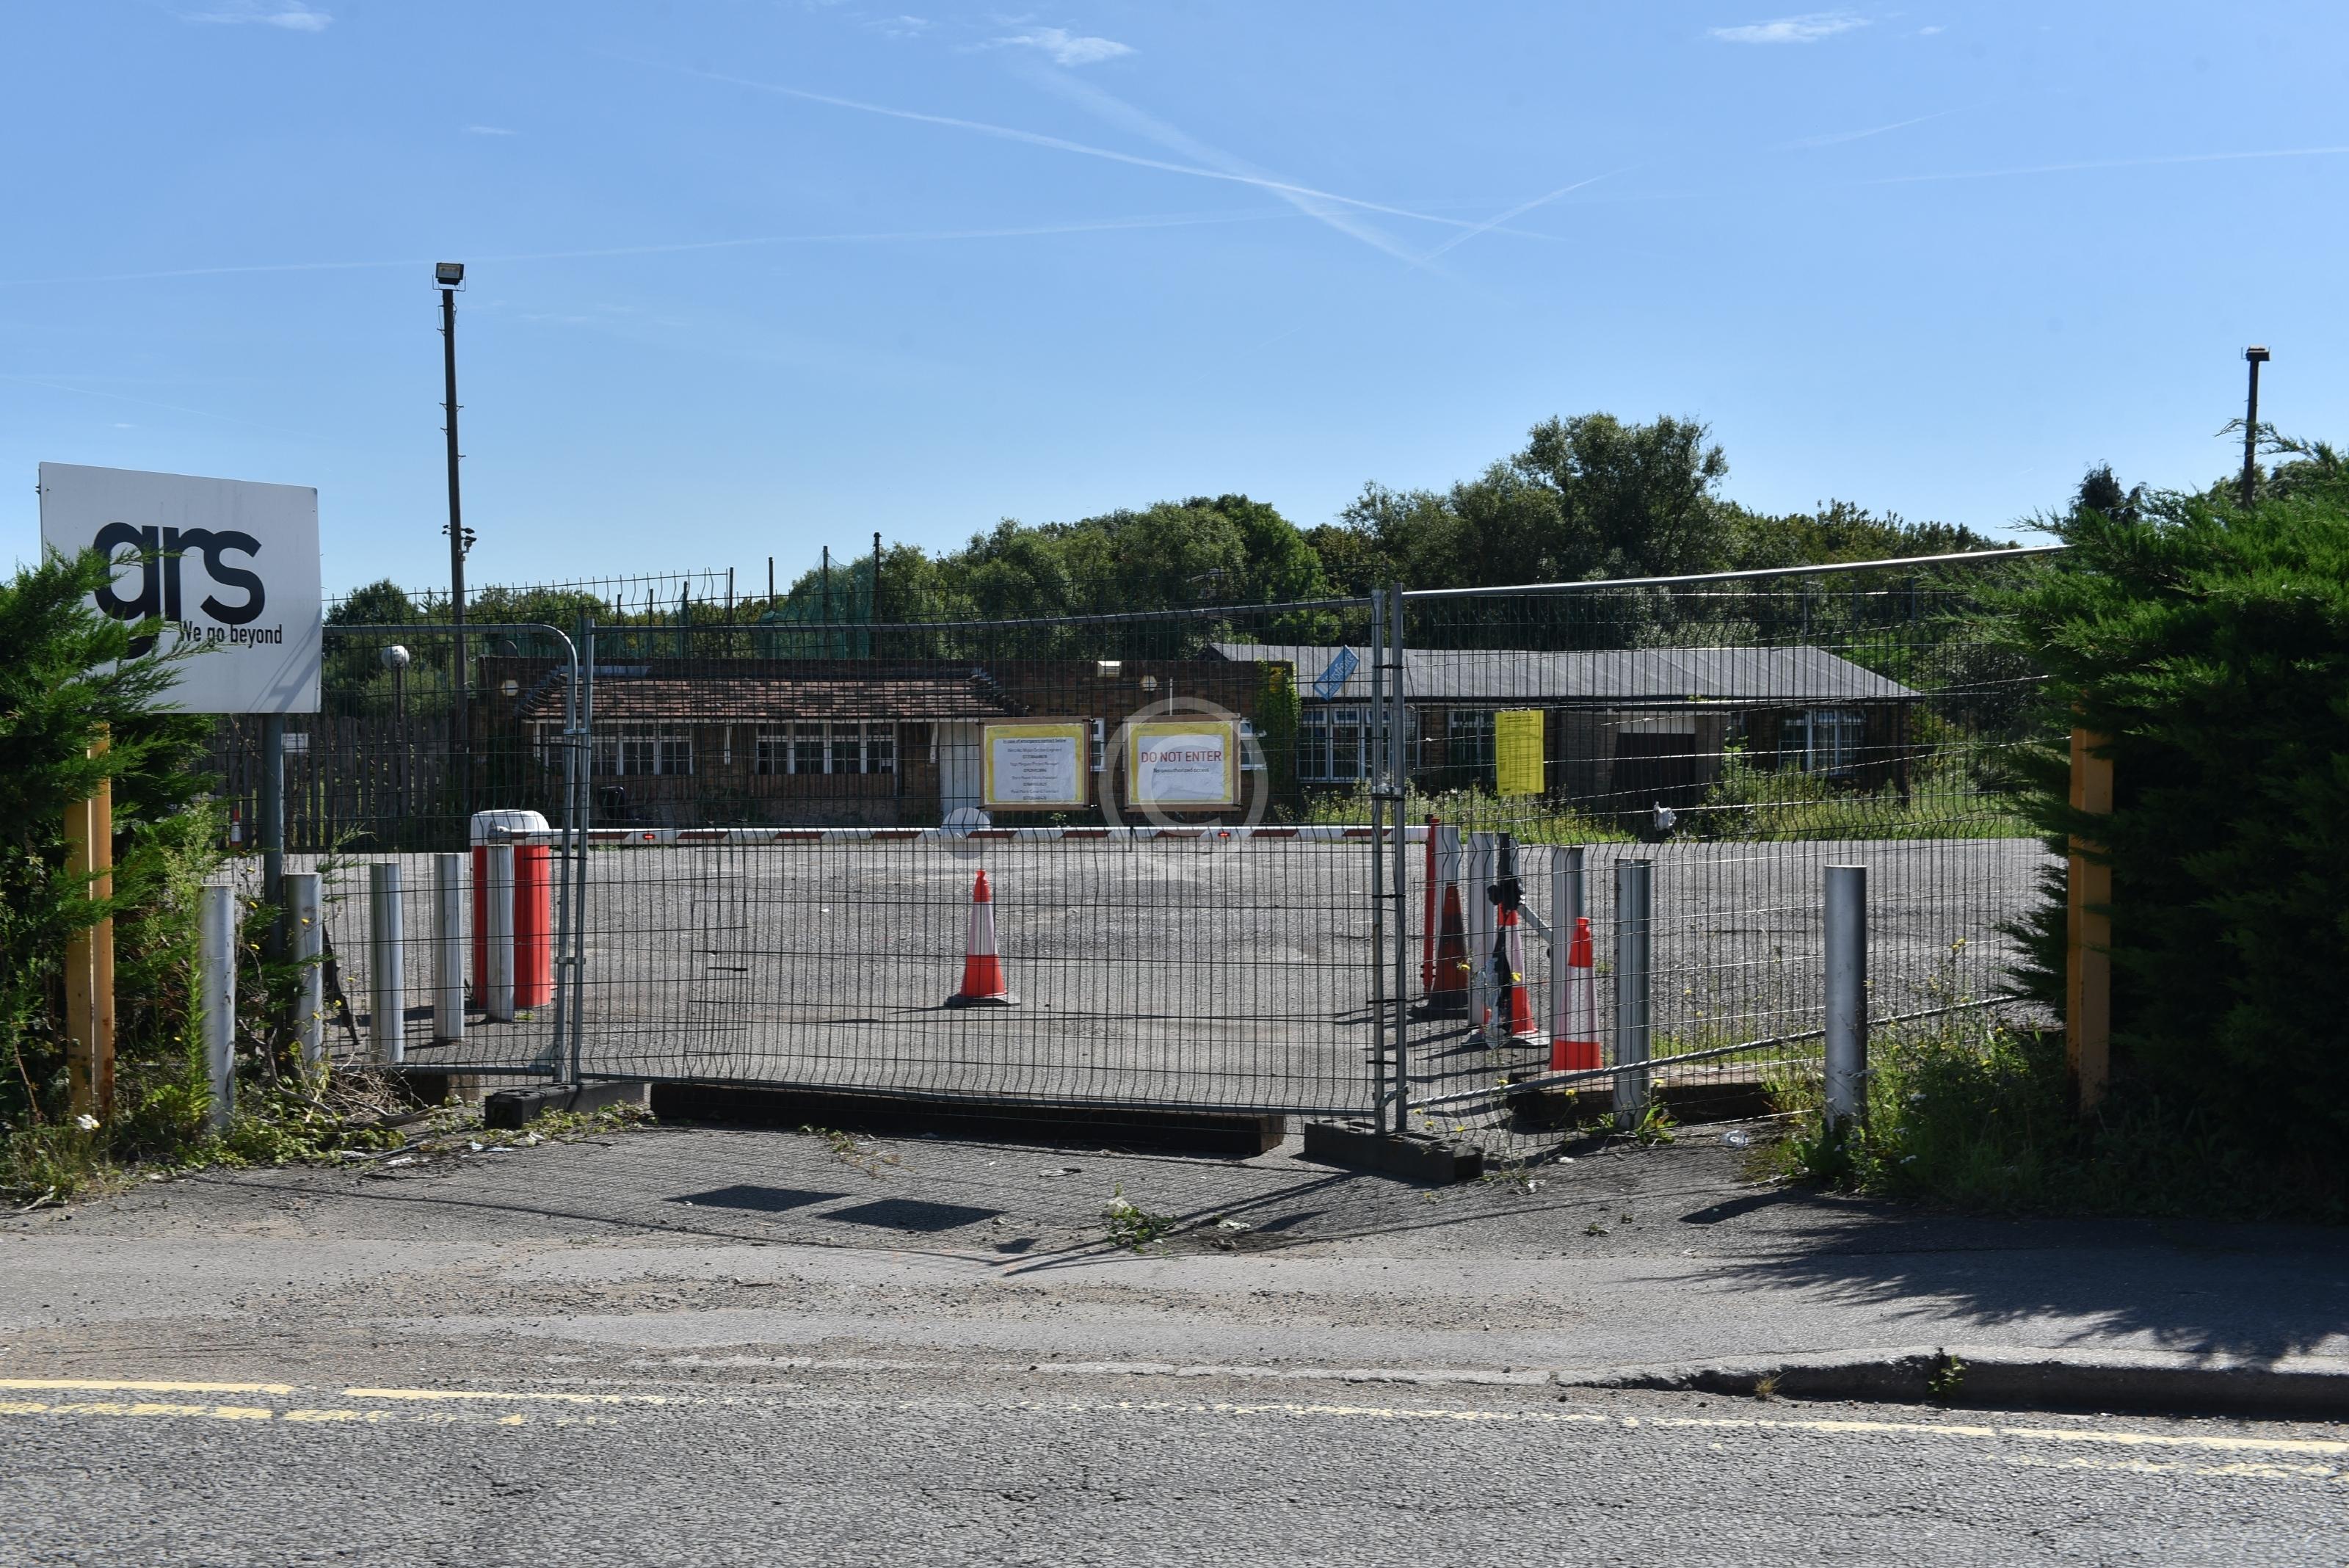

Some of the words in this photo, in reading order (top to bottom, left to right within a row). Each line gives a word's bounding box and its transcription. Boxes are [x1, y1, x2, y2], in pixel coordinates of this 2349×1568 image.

[181, 621, 201, 642] We
[207, 627, 225, 647] go
[230, 623, 282, 648] beyond
[1141, 752, 1157, 763] DO
[1161, 752, 1183, 763] NOT
[1186, 751, 1221, 762] ENTER
